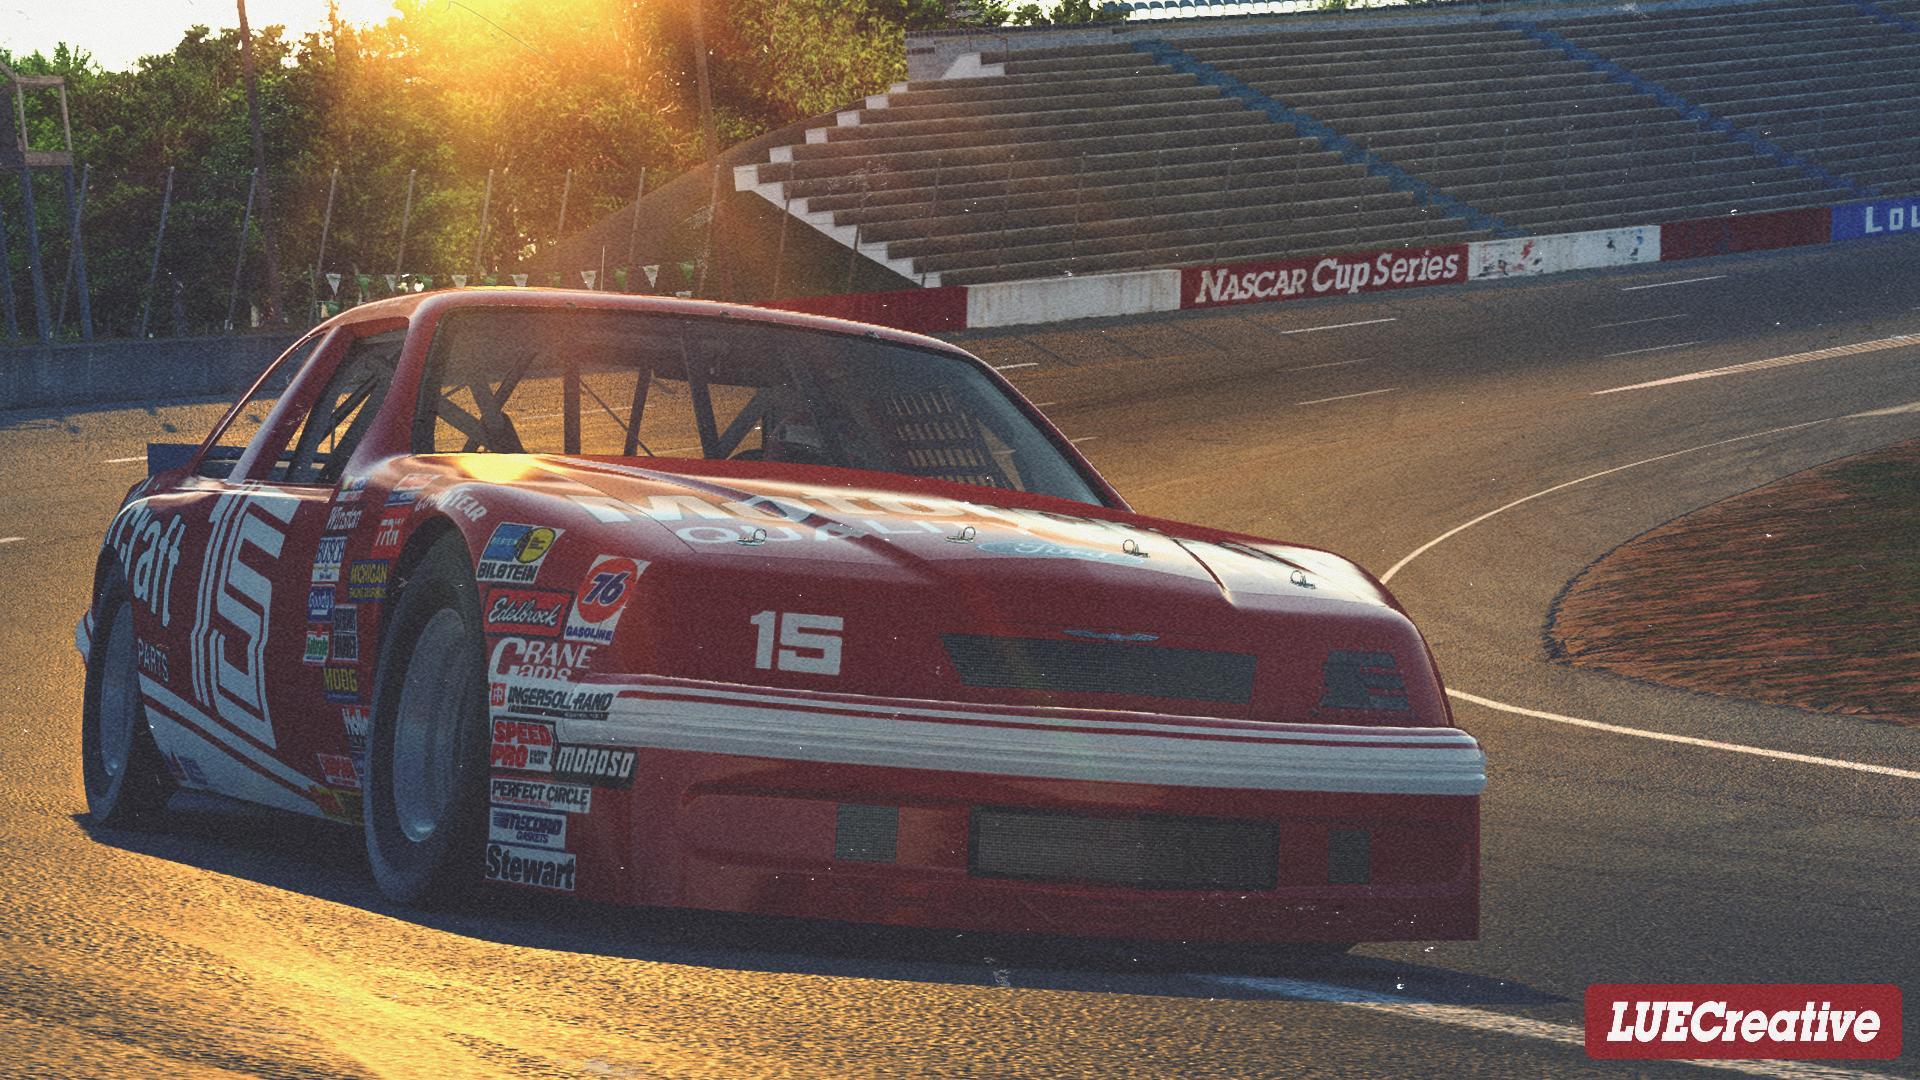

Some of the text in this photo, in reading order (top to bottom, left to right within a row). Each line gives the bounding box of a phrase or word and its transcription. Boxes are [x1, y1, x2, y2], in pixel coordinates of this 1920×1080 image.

[1195, 250, 1460, 304] NASCAR Cup Series
[477, 561, 539, 583] BILSTEIN
[582, 571, 632, 606] 76
[190, 480, 303, 751] 15
[488, 597, 562, 627] Edelbrock
[565, 626, 613, 641] GASOLINE
[750, 610, 844, 676] 15
[323, 668, 358, 692] MOOG
[493, 721, 553, 747] SPEED
[491, 743, 529, 768] PRO
[556, 746, 636, 778] MOROSO
[492, 780, 546, 800] PERFECT
[546, 786, 590, 806] CIRCLE
[486, 844, 575, 889] Stewart
